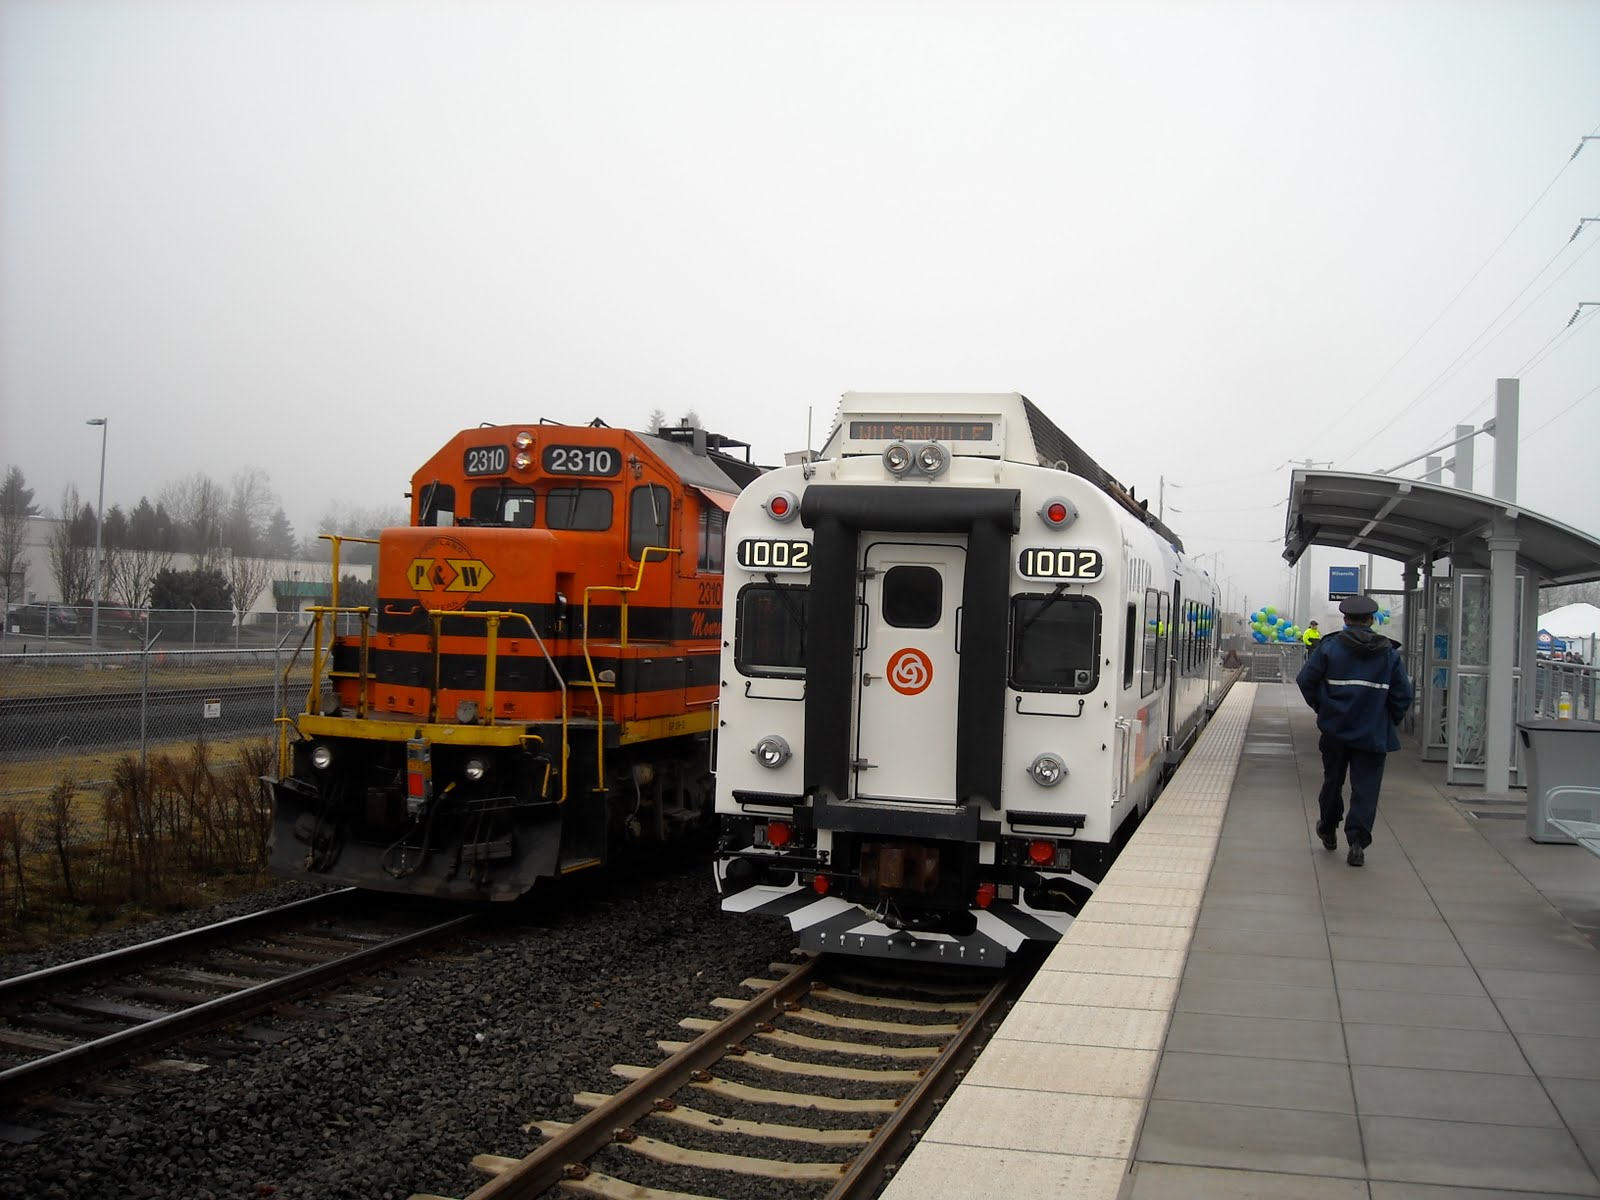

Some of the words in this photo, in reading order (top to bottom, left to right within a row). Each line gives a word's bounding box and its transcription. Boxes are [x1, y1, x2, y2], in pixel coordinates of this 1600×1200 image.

[468, 448, 505, 472] 2310
[551, 448, 612, 473] 2310
[745, 541, 809, 567] 1002
[1027, 550, 1097, 577] 1002
[415, 565, 425, 585] P
[460, 566, 482, 587] W
[698, 581, 722, 605] 2310
